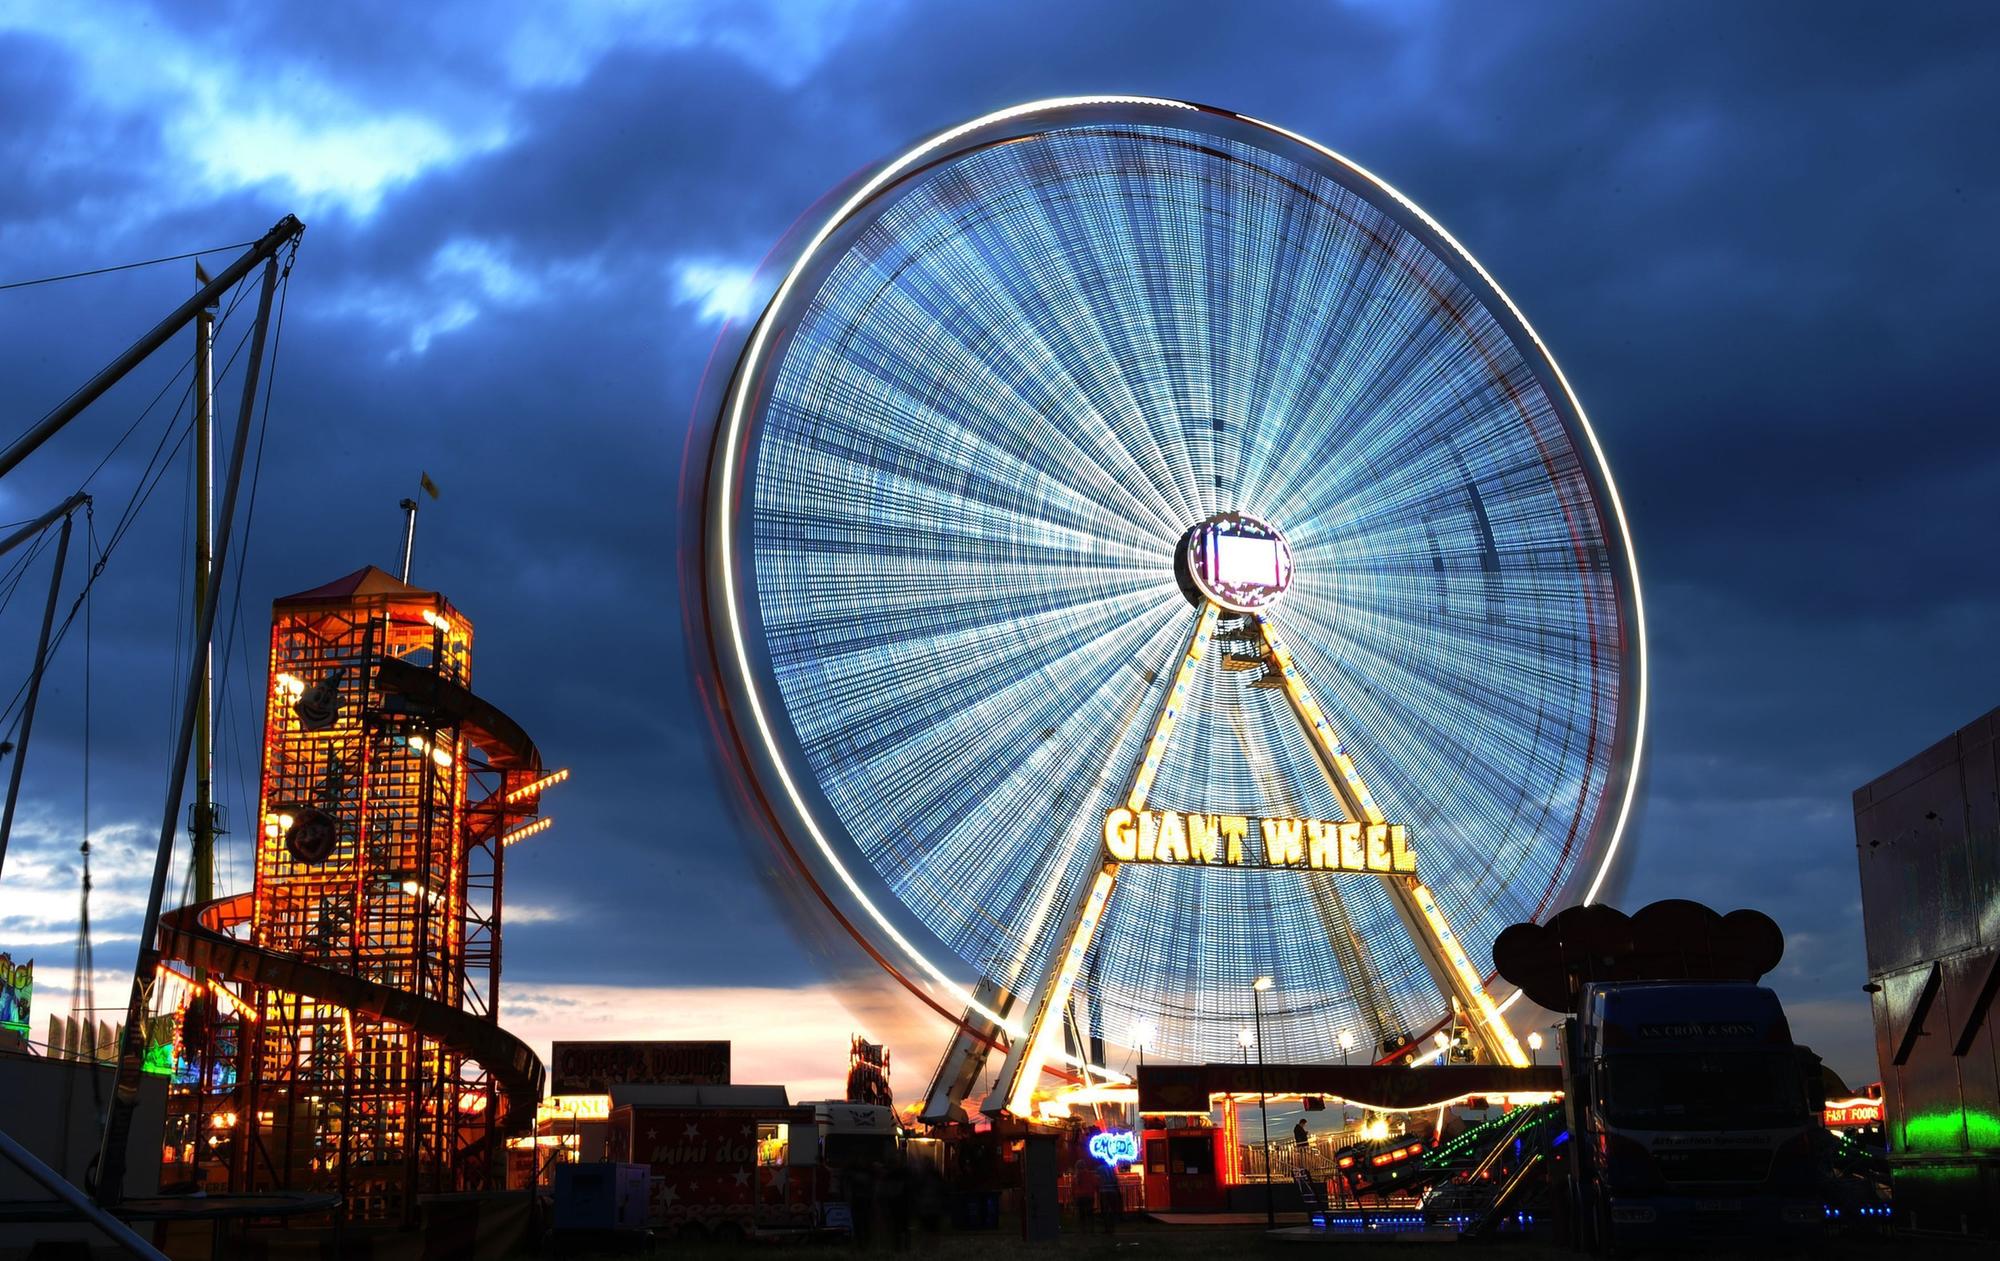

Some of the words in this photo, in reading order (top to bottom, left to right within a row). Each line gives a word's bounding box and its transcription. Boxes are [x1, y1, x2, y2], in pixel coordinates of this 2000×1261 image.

[1106, 808, 1247, 864] GIANT
[1265, 819, 1417, 871] WHEEL
[1664, 1024, 1703, 1037] CROW
[1707, 1025, 1717, 1036] &
[1720, 1023, 1755, 1035] SONS
[561, 1049, 627, 1077] COFFEE
[653, 1047, 725, 1076] DONUTS
[1825, 1109, 1846, 1121] FAST
[1850, 1106, 1879, 1120] FOODS
[1651, 1135, 1712, 1146] Attraction
[650, 1139, 708, 1165] mini
[715, 1139, 754, 1163] do
